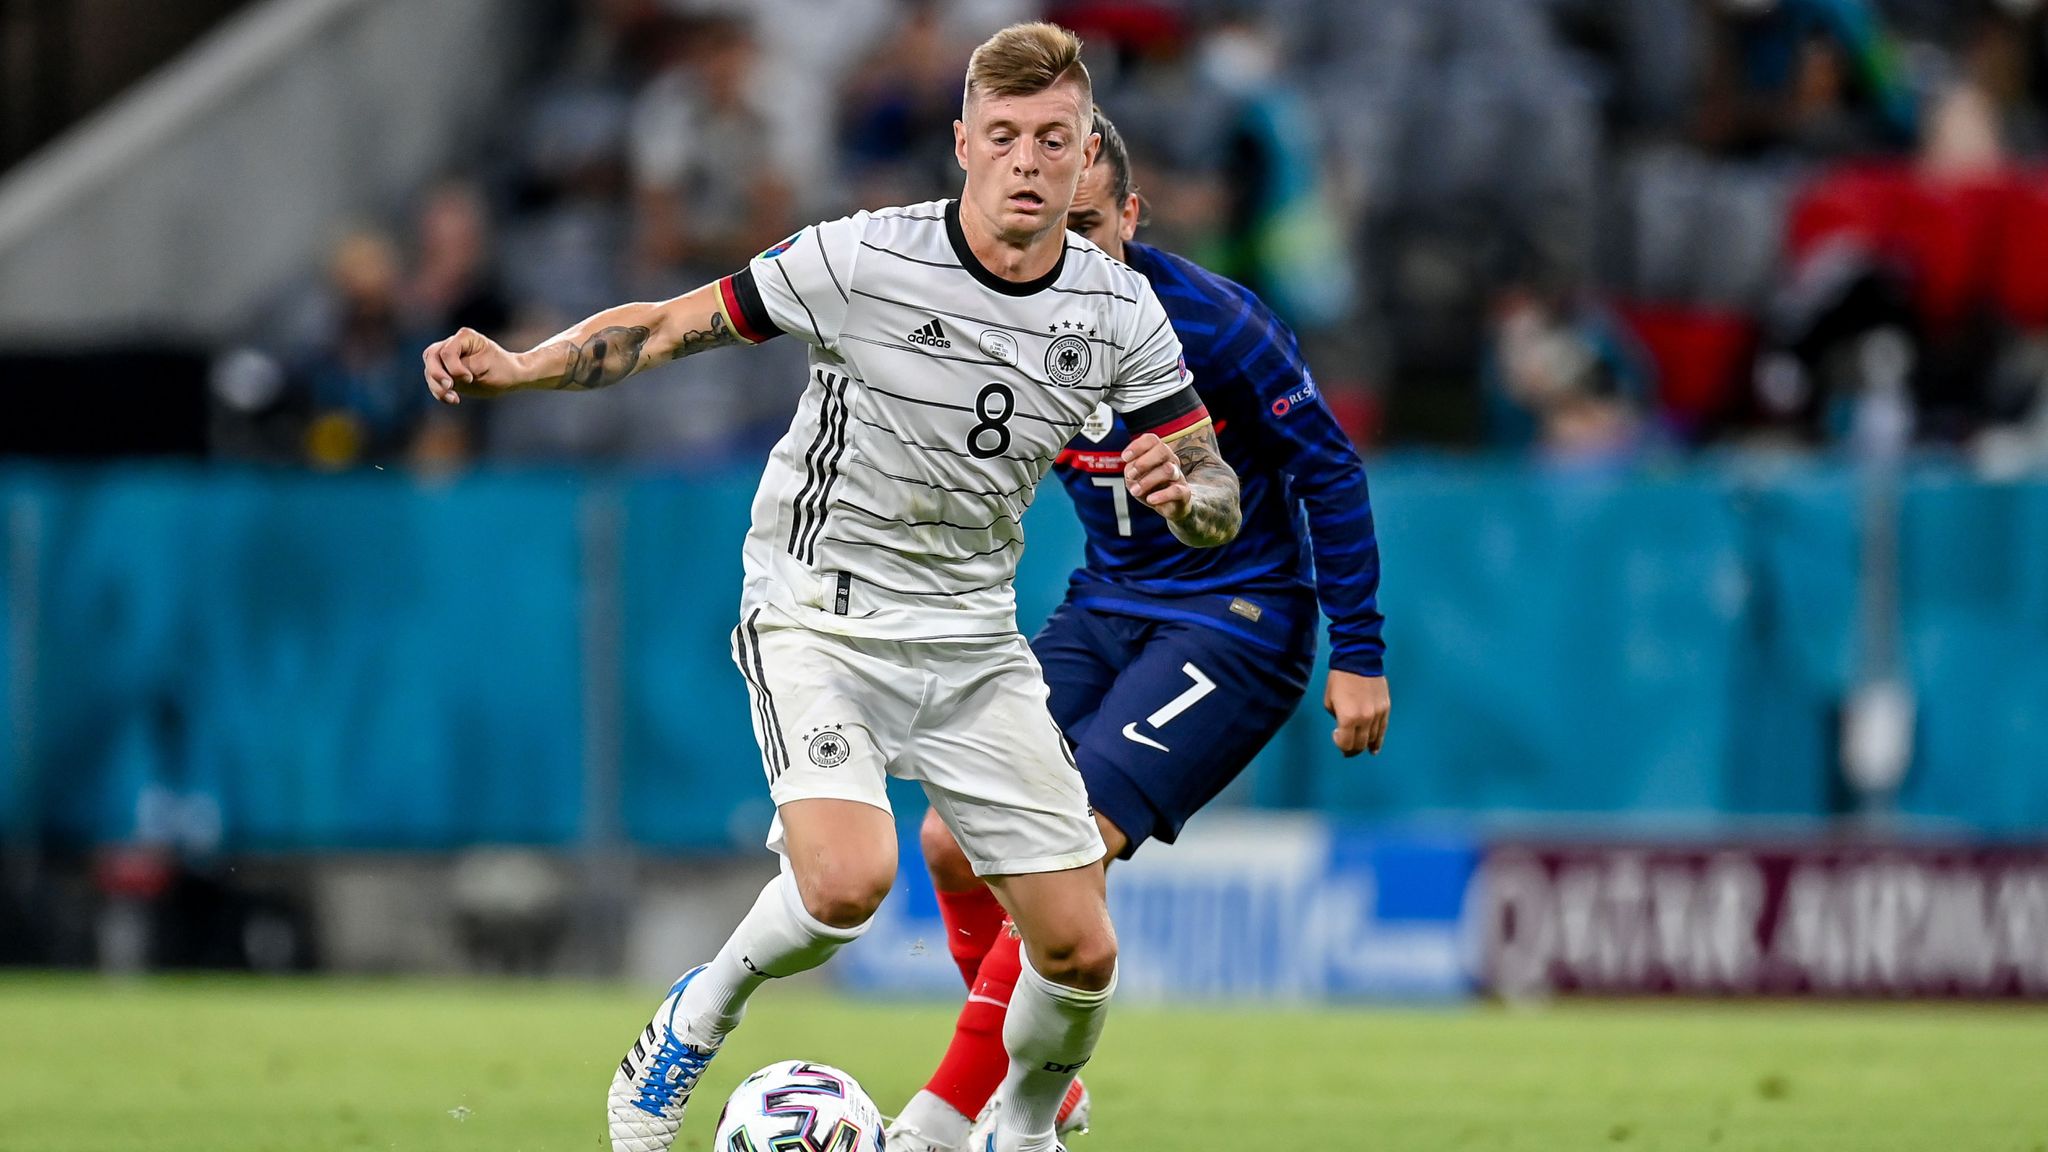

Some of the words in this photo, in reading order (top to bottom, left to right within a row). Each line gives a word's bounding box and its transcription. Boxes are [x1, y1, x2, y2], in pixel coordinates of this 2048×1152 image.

[907, 333, 951, 348] adidas
[966, 382, 1016, 460] 8
[1289, 384, 1315, 405] RES
[1091, 477, 1132, 536] 7
[1147, 661, 1218, 729] 7
